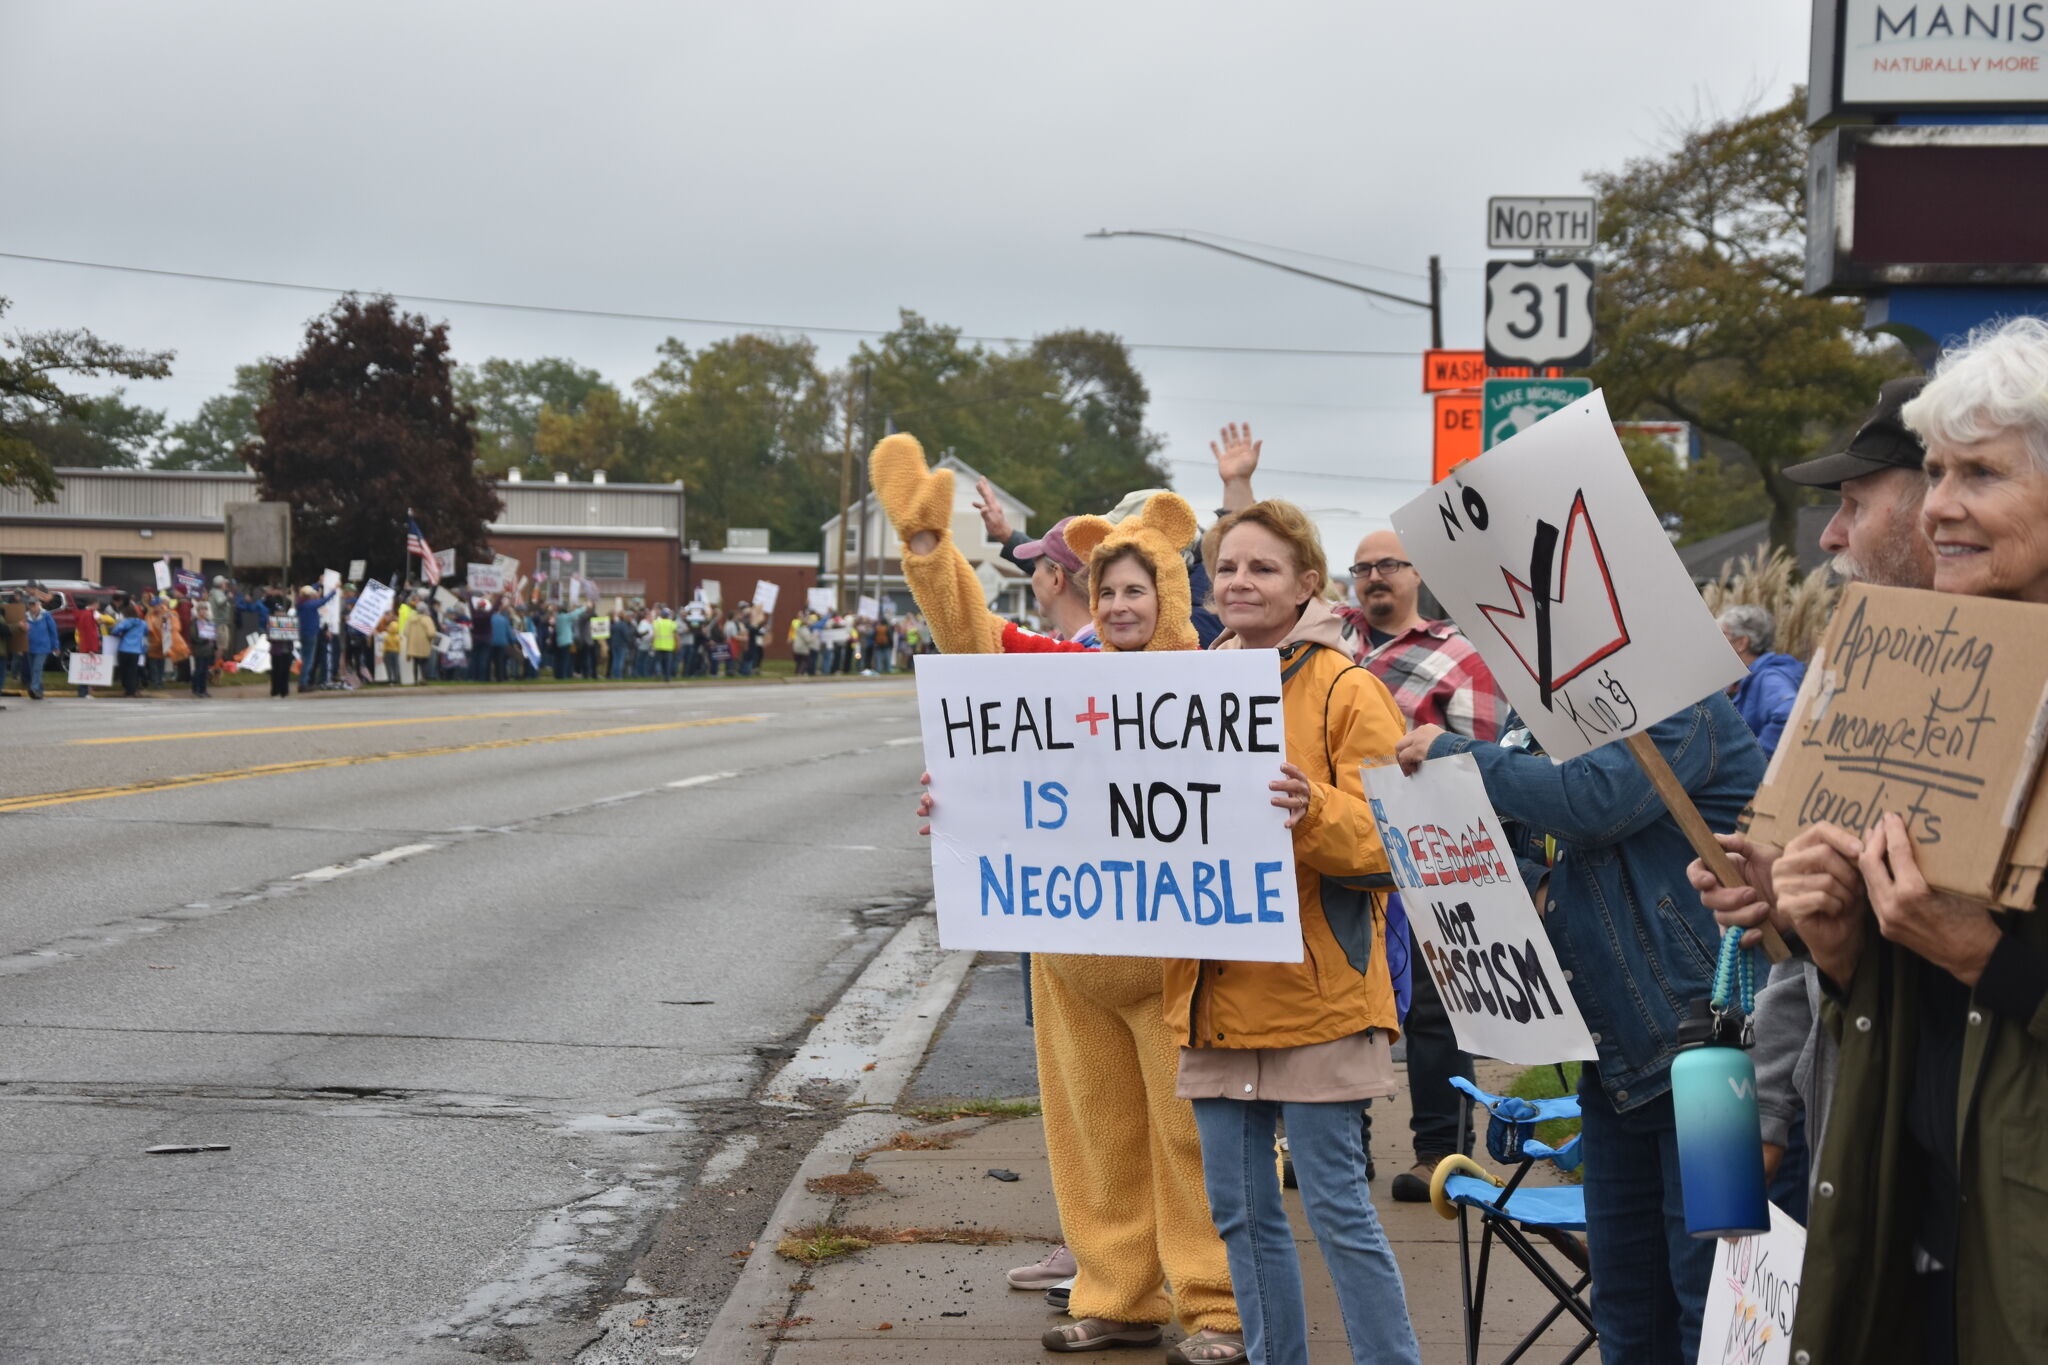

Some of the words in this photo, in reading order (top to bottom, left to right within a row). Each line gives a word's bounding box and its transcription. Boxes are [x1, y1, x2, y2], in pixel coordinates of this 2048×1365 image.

[1876, 4, 2045, 42] MANIS
[1873, 57, 1982, 72] NATURALLY
[1987, 56, 2040, 72] MORE
[1495, 206, 1589, 240] NORTH
[1506, 282, 1569, 339] 31
[1490, 388, 1523, 410] LAKE
[1438, 486, 1489, 542] NO
[1833, 596, 1994, 712] Appointing
[1801, 686, 1997, 772] Incompetent
[1023, 780, 1069, 830] IS
[1108, 781, 1221, 845] NOT
[1369, 798, 1511, 888] FREEDOM
[979, 853, 1285, 926] NEGOTIABLE
[1431, 901, 1481, 949] NOT
[1422, 937, 1564, 1025] FASCISM
[1726, 1235, 1752, 1285] NO
